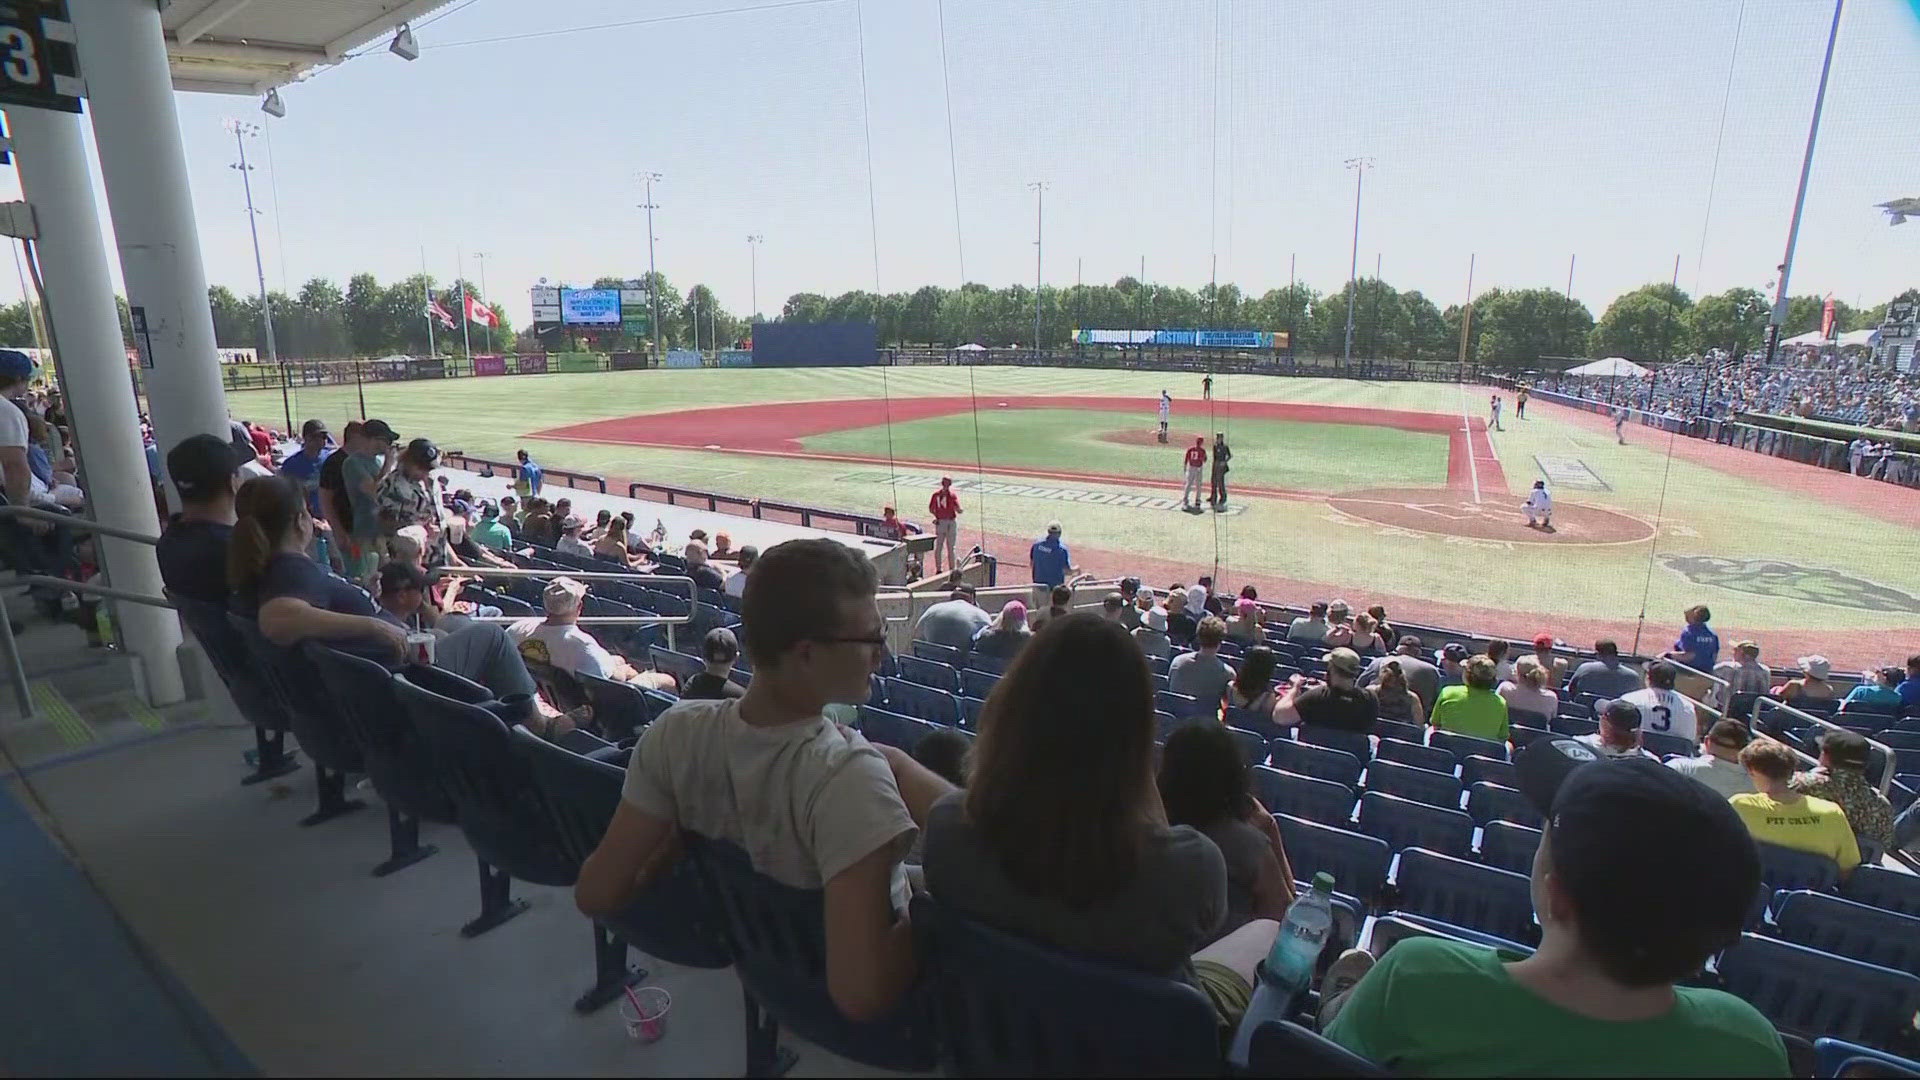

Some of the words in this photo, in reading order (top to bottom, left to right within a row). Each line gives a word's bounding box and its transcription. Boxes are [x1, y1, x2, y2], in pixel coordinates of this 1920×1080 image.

[0, 26, 40, 85] 3
[936, 495, 948, 509] 14
[1651, 705, 1671, 732] 3
[1766, 816, 1785, 825] PIT
[1788, 815, 1821, 825] CREW
